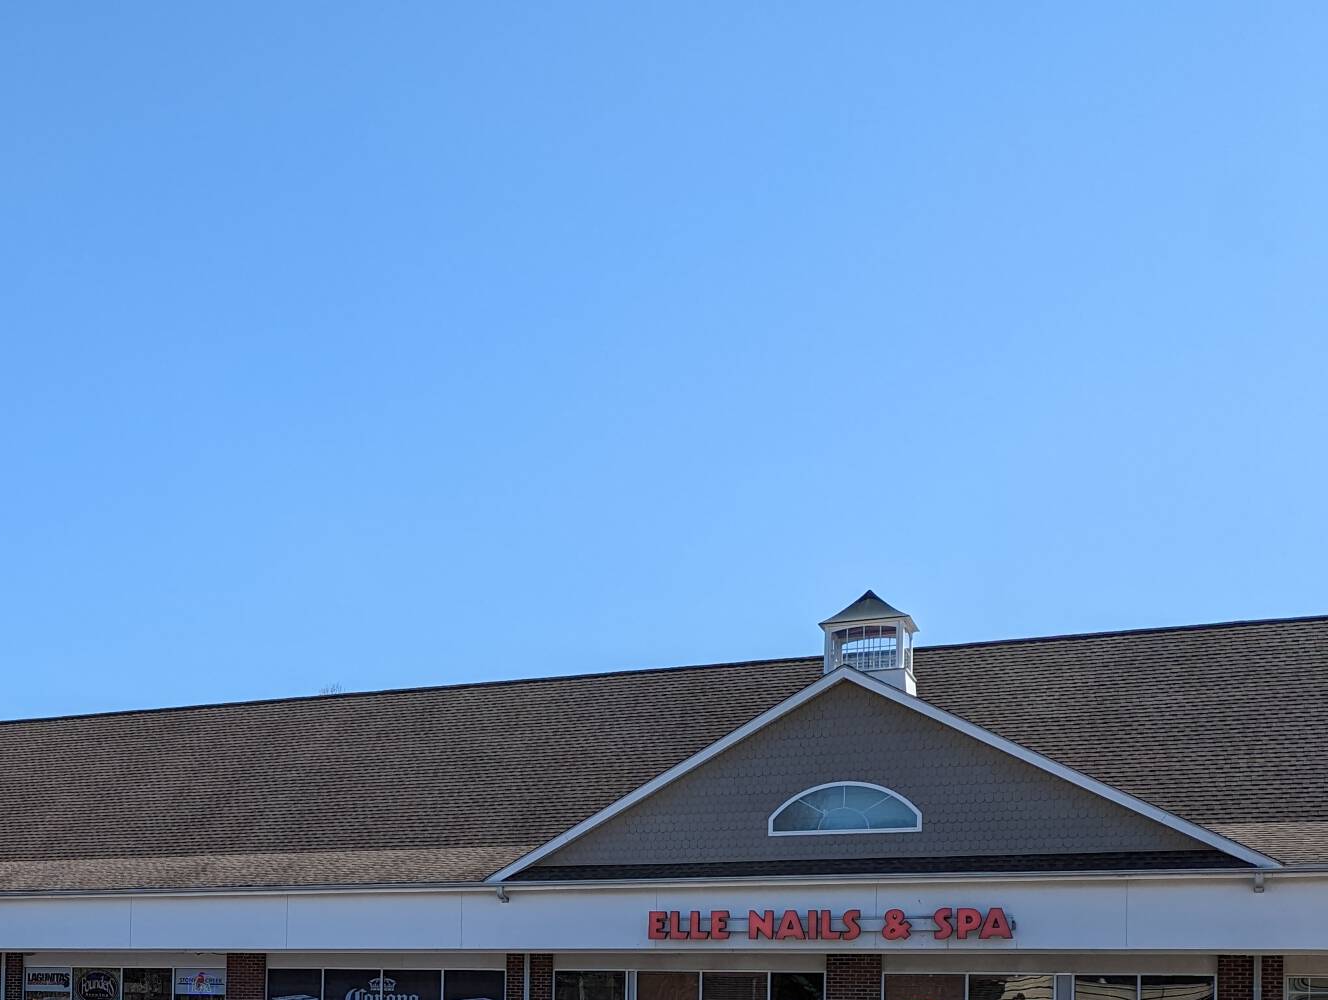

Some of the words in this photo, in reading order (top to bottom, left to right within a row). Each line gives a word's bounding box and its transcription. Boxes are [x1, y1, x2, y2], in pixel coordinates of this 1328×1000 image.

[648, 911, 731, 940] ELLE
[748, 910, 861, 940] NAILS
[881, 908, 913, 941] &
[933, 907, 1013, 940] SPA
[27, 972, 71, 988] LAGUNITAS
